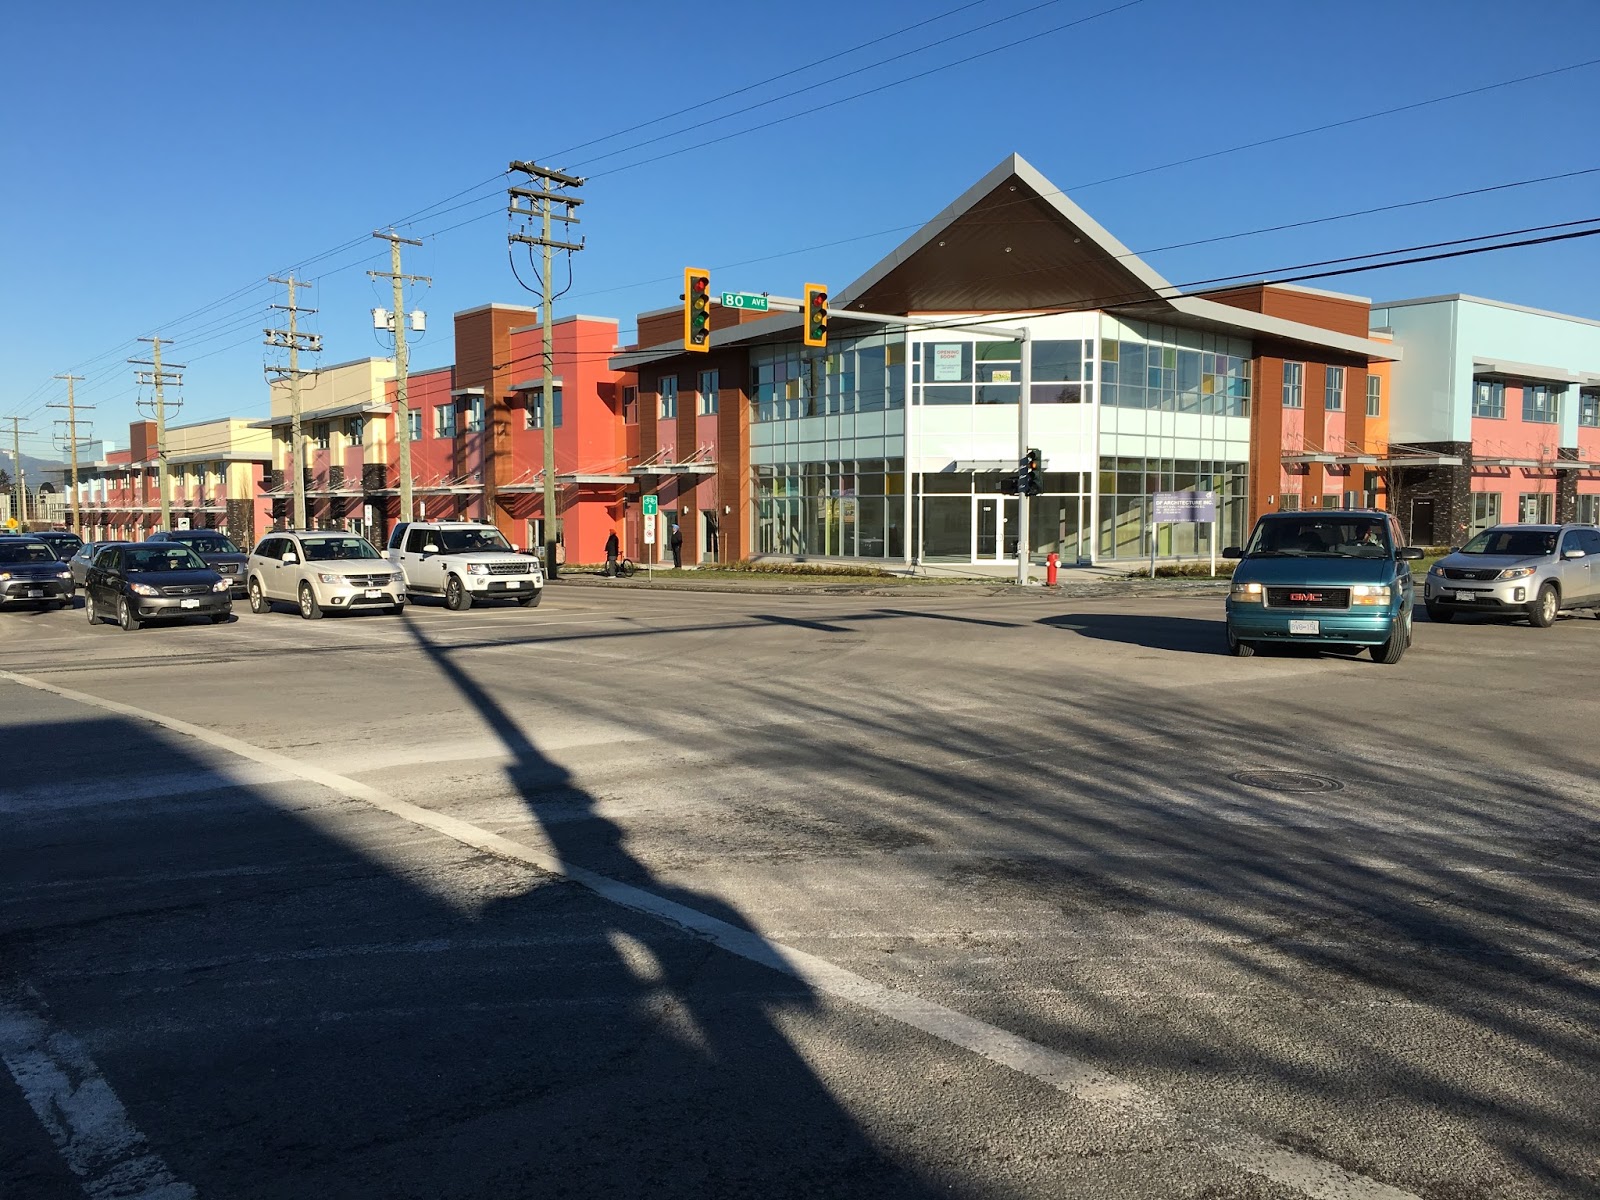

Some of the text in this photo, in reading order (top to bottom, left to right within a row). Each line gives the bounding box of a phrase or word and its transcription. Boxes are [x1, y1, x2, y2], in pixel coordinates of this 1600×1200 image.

[726, 294, 765, 307] 80 AVE
[1290, 593, 1322, 601] GMC
